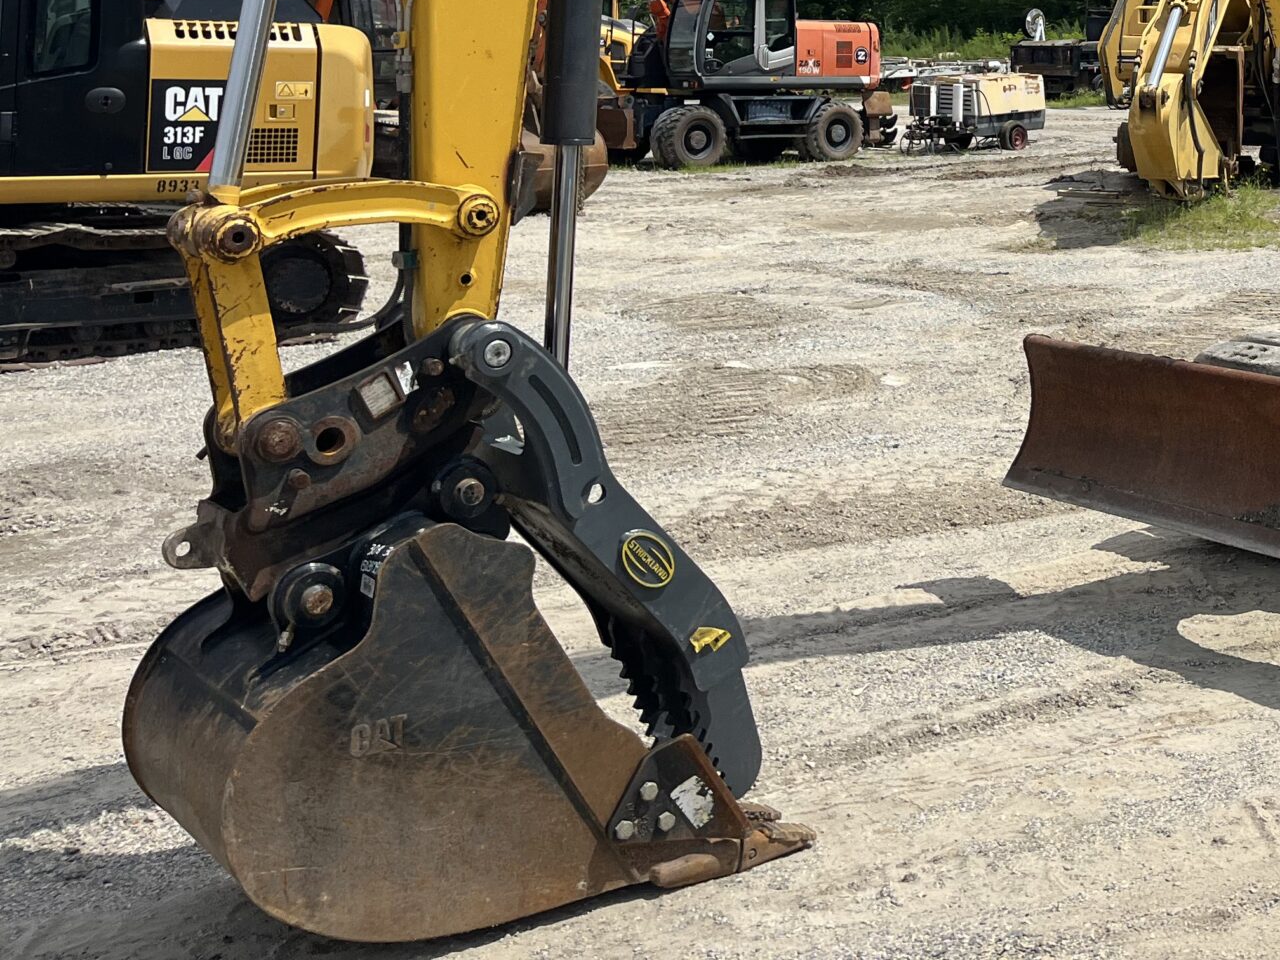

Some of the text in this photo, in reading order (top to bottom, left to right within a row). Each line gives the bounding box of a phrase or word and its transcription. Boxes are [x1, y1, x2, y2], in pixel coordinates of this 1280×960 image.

[799, 59, 821, 67] ZAXIS
[857, 51, 866, 60] Z
[165, 86, 223, 121] CAT
[163, 126, 204, 144] 313F
[162, 146, 192, 160] L GC
[629, 540, 668, 580] STRICKLAND
[350, 714, 408, 758] CAT
